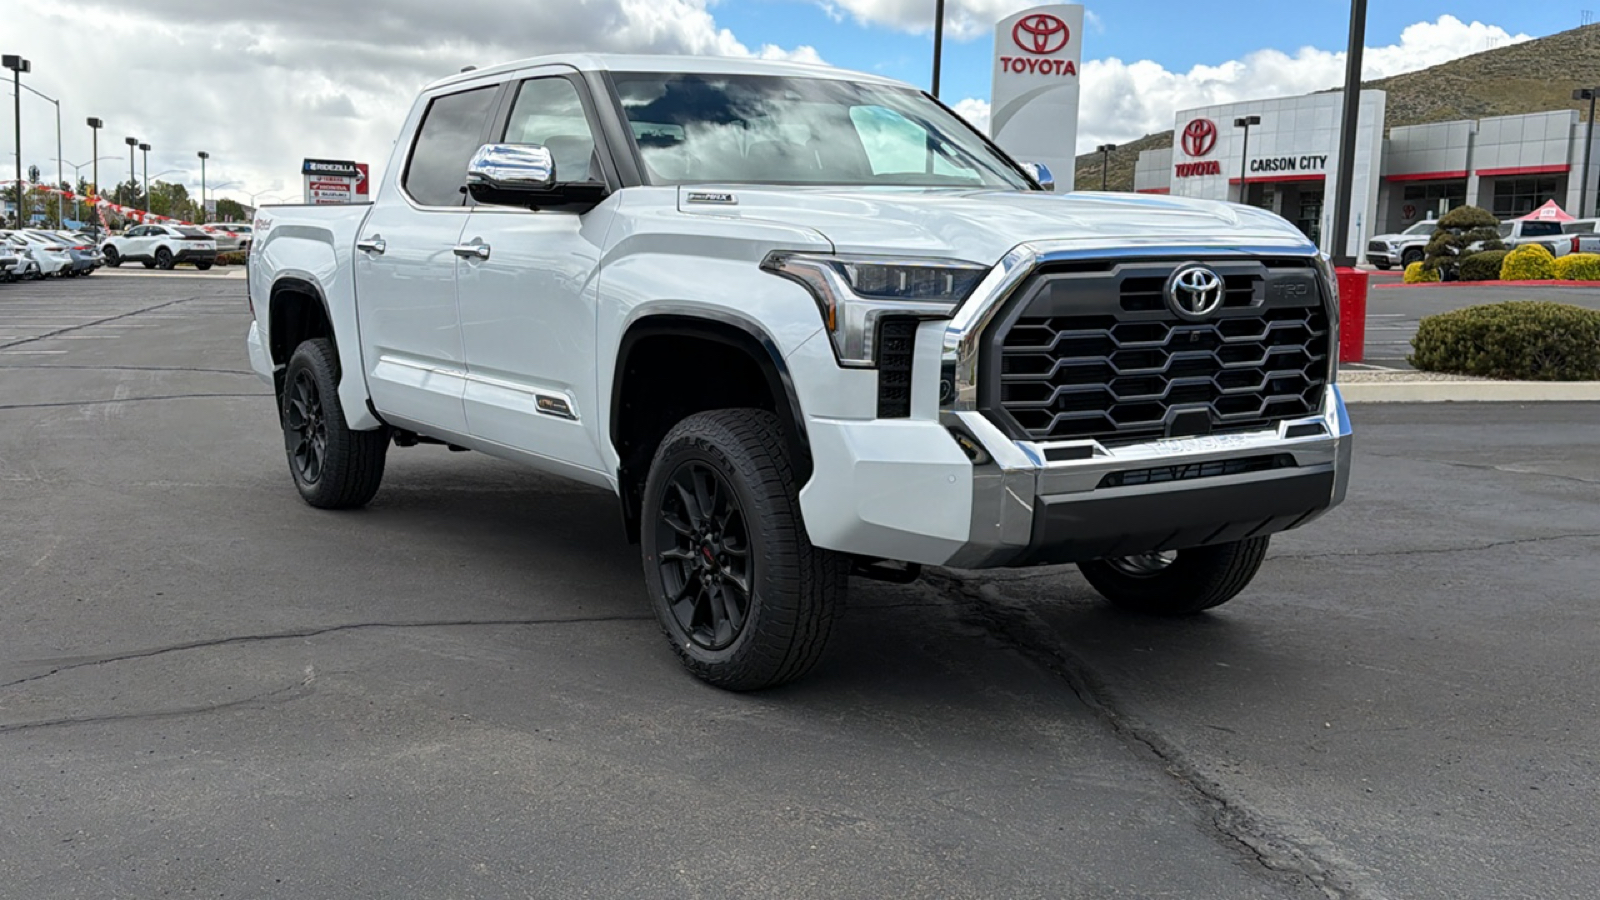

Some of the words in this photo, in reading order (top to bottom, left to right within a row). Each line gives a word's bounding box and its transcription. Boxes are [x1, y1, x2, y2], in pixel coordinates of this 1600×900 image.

[1000, 56, 1076, 76] TOYOTA
[316, 163, 355, 172] RIDEZILLA
[1174, 160, 1221, 178] TOYOTA
[1250, 157, 1296, 172] CARSON
[1299, 155, 1328, 170] CITY
[1273, 284, 1307, 299] TRD
